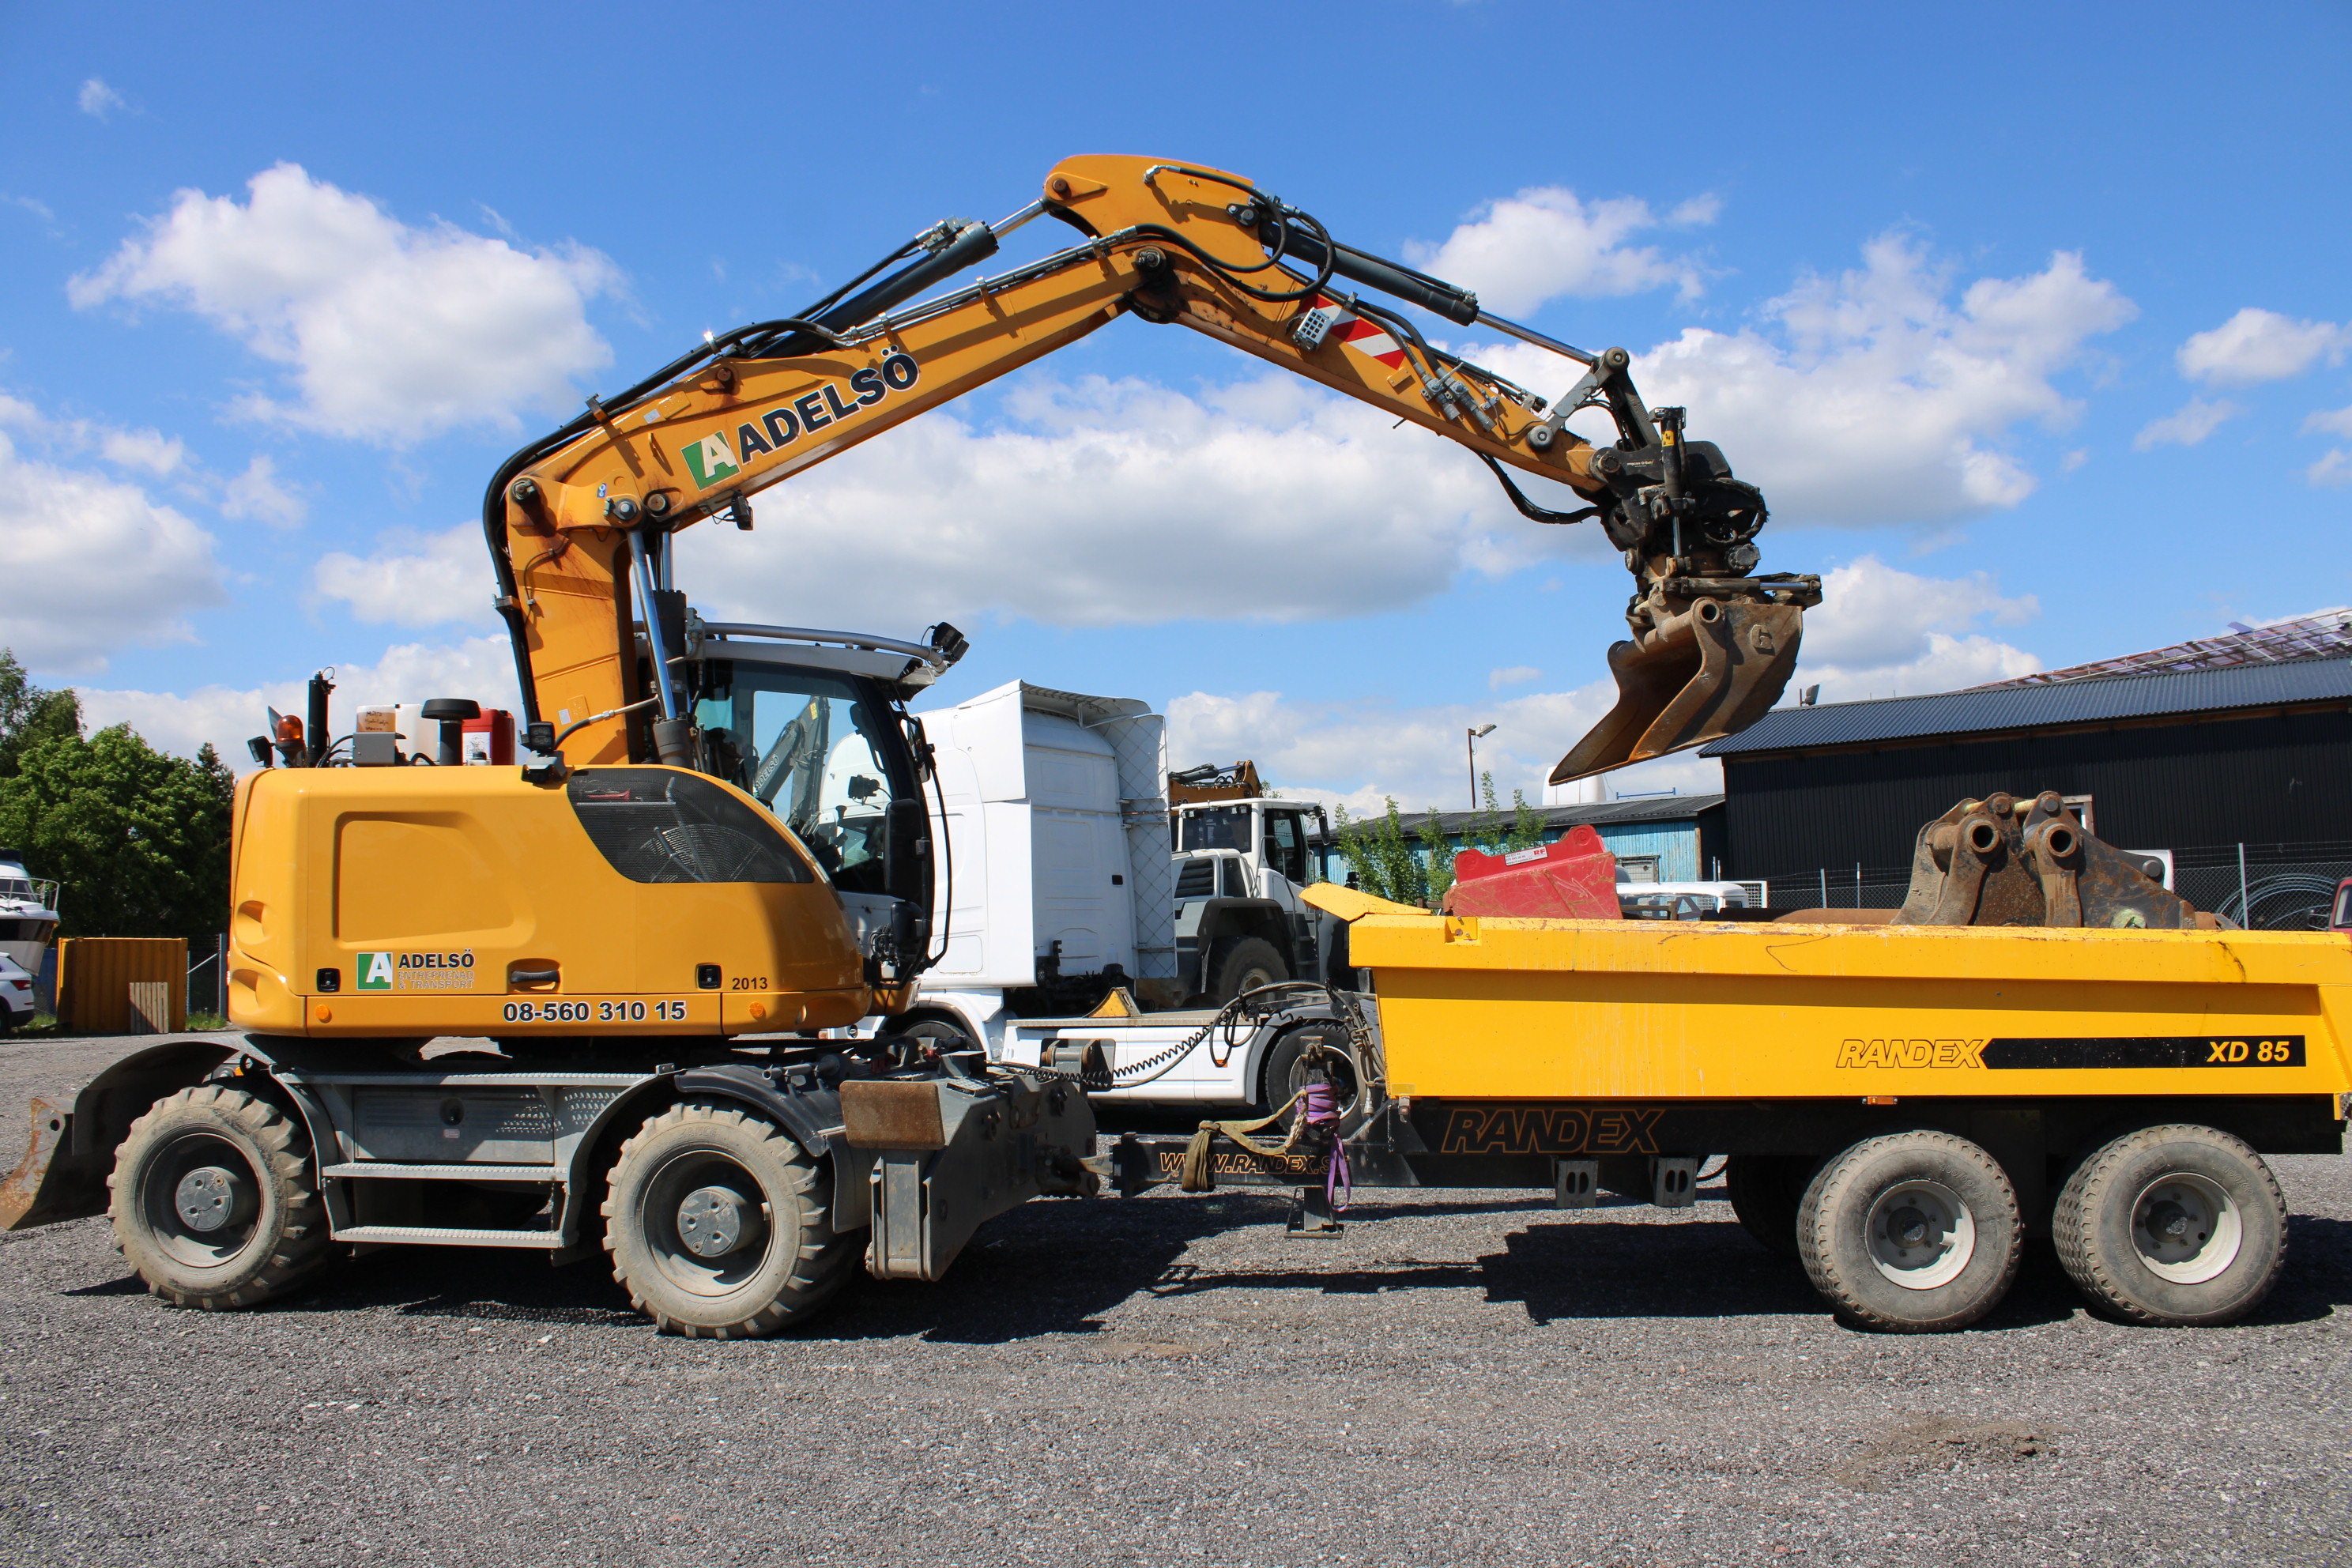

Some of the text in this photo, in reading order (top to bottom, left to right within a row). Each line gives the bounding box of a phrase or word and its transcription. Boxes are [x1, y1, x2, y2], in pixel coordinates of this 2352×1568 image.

[737, 344, 921, 466] ADELSÖ
[398, 948, 475, 969] ADELSÖ
[398, 971, 475, 980] ENTREPRENAD
[398, 980, 475, 989] & TRANSPORT
[732, 977, 768, 990] 2013
[503, 1001, 687, 1022] 08-560 310 15
[1836, 1038, 2290, 1069] RANDEX XD 85
[1441, 1108, 1667, 1154] RANDEX
[1159, 1152, 1350, 1175] WW.RANDEX.S
